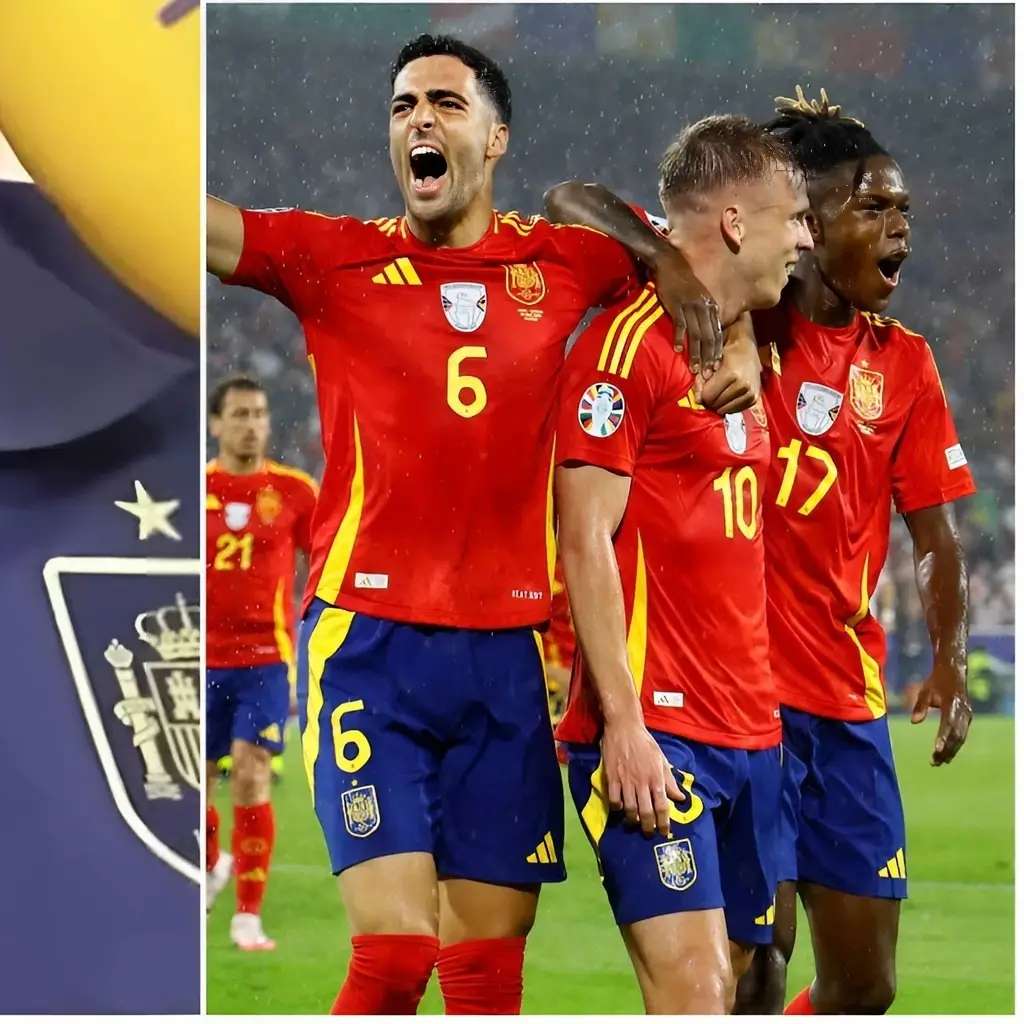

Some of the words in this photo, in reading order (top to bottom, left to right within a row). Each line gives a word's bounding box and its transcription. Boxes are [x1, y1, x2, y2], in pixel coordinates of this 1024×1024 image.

[446, 346, 488, 418] 6
[713, 465, 758, 540] 10
[775, 438, 838, 516] 17
[214, 531, 254, 571] 21
[330, 699, 372, 773] 6
